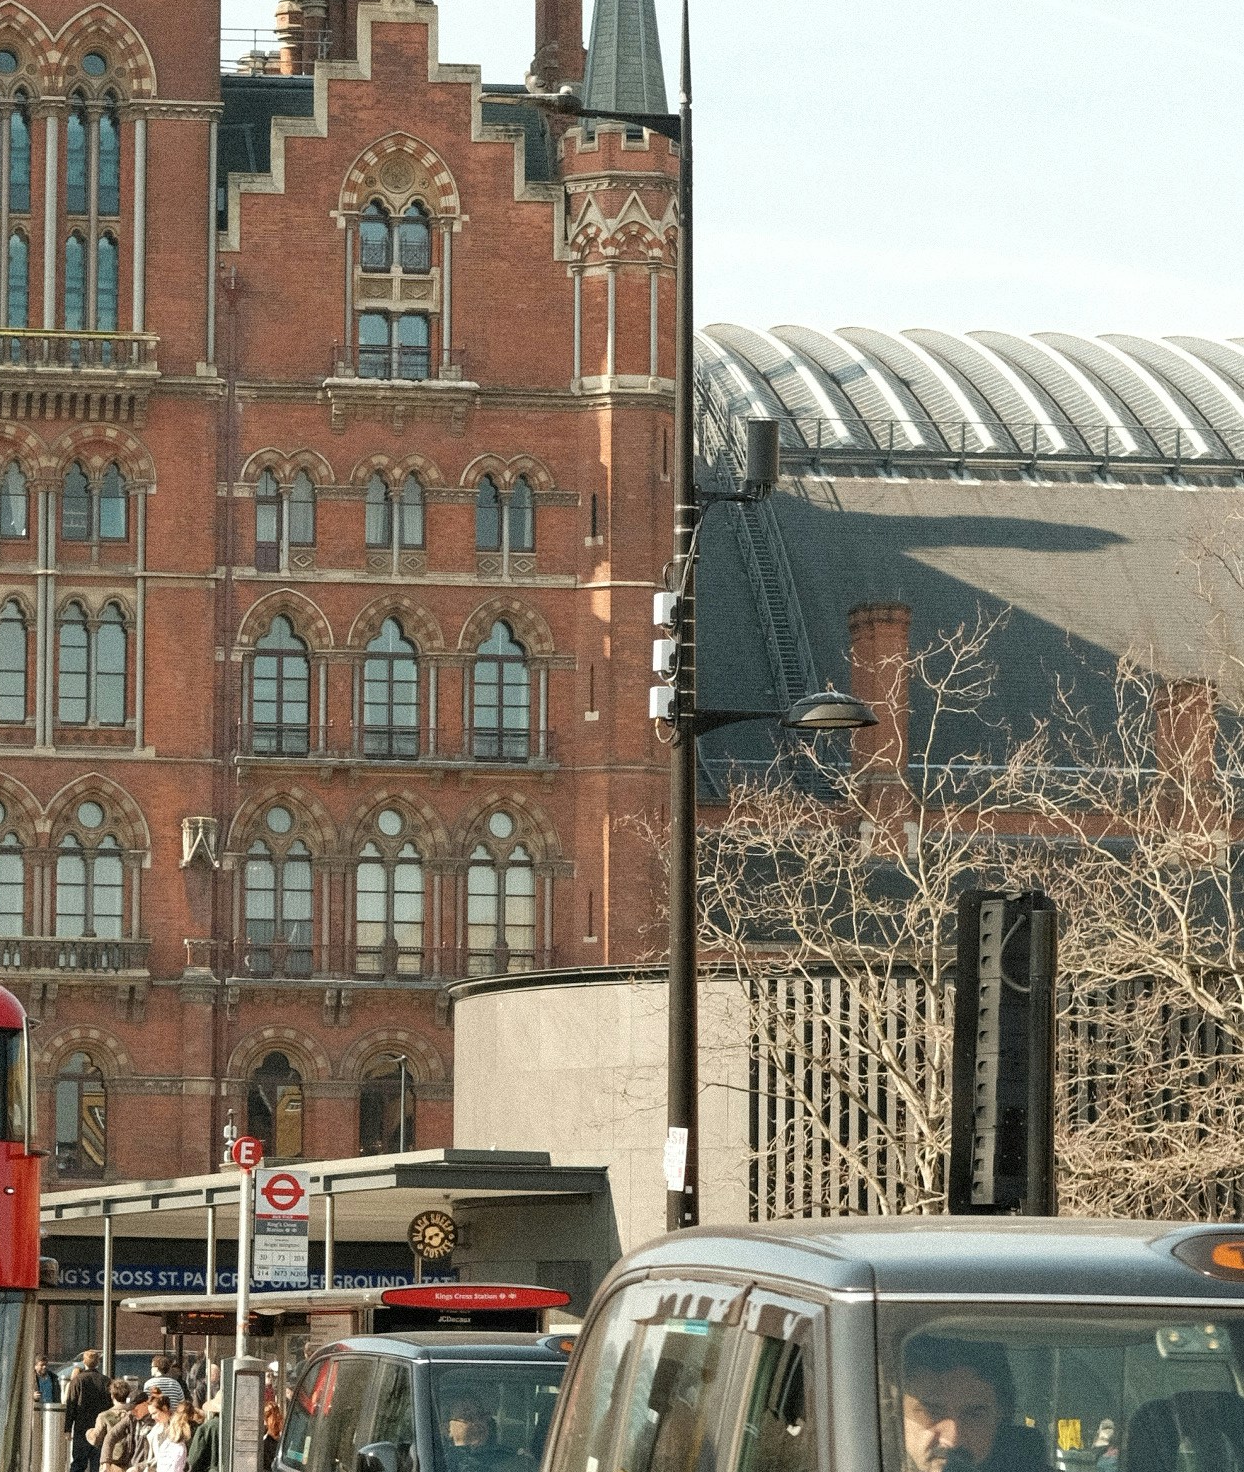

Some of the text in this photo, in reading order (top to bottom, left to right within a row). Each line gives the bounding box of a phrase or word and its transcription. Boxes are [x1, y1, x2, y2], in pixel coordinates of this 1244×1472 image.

[240, 1141, 255, 1164] E
[412, 1213, 454, 1242] BLACK SHEEP
[423, 1239, 454, 1259] COFFEE
[96, 1270, 153, 1286] CROSS
[158, 1271, 180, 1286] ST.
[435, 1292, 453, 1301] Kings
[438, 1315, 472, 1323] JCDecaux
